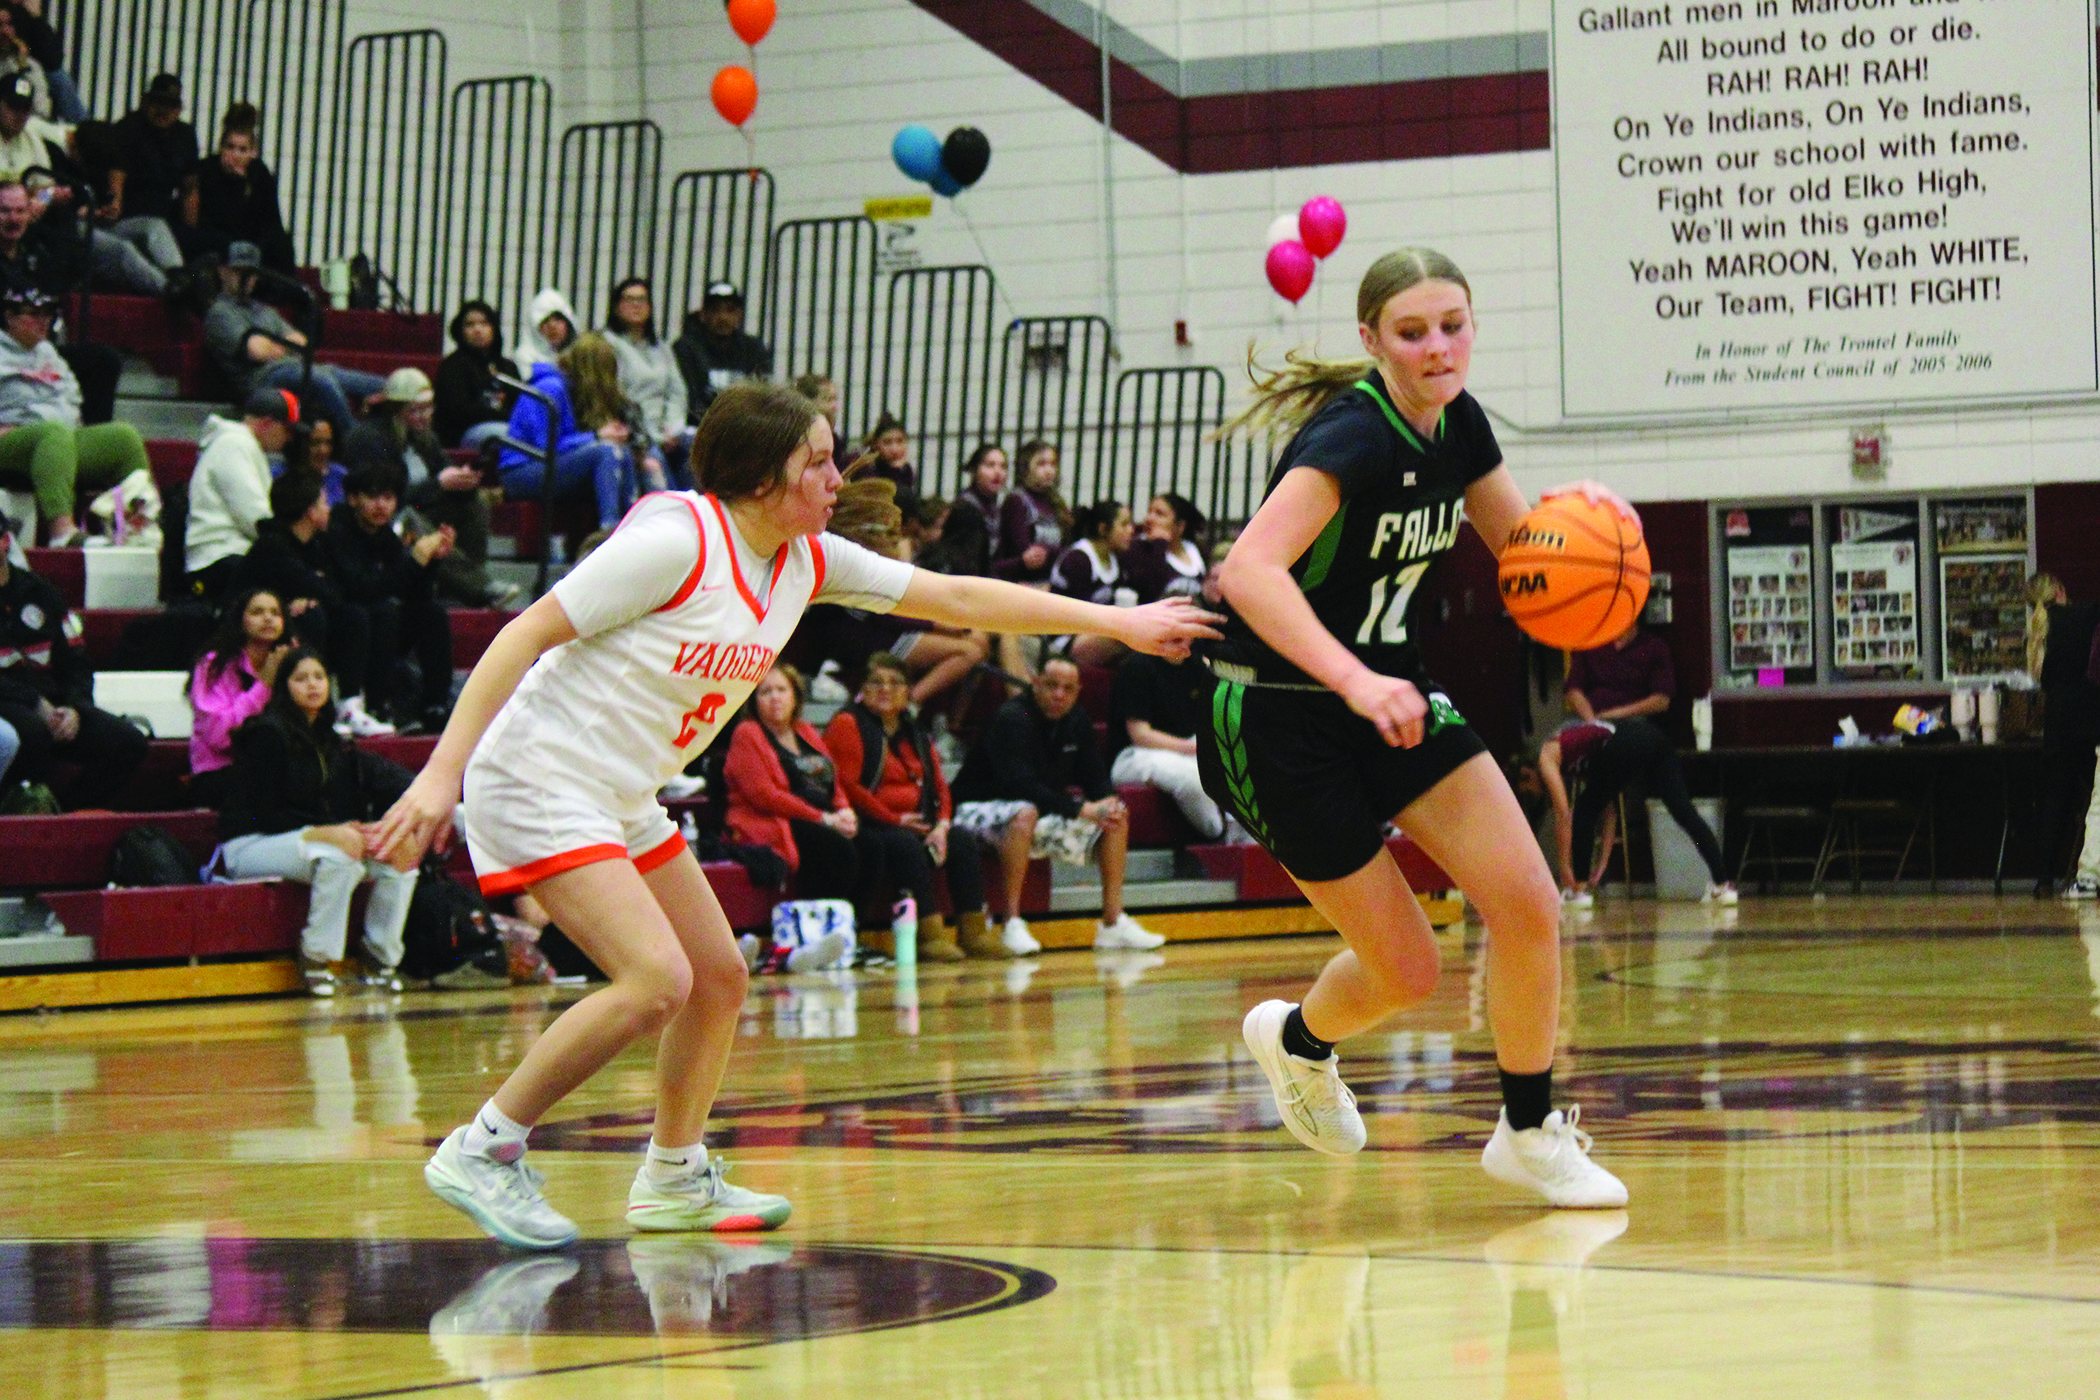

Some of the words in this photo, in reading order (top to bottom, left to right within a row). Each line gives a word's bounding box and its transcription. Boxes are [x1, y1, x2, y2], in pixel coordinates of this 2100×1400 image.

[1578, 5, 1672, 34] Gallant
[1686, 1, 1743, 24] men
[1756, 0, 1779, 18] in
[1657, 38, 1689, 64] All
[1701, 29, 1786, 60] bound
[1800, 29, 1828, 52] to
[1840, 24, 1876, 50] do
[1889, 25, 1918, 46] or
[1931, 16, 1981, 43] die.
[1707, 68, 1771, 97] RAH!
[1784, 62, 1850, 91] RAH!
[1863, 56, 1929, 85] RAH!
[1613, 115, 1651, 142] On
[1663, 113, 1695, 137] Ye
[1707, 108, 1812, 136] Indians,
[1825, 100, 1864, 126] On
[1877, 96, 1909, 122] Ye
[1922, 91, 2031, 119] Indians,
[1617, 152, 1703, 178] Crown
[1716, 151, 1760, 171] our
[1773, 137, 1866, 168] school
[1878, 132, 1936, 160] with
[1950, 130, 2028, 155] fame.
[1657, 187, 1723, 215] Fight
[1738, 182, 1775, 206] for
[1789, 177, 1831, 203] old
[1844, 173, 1905, 200] Elko
[1917, 167, 1987, 199] High,
[1670, 217, 1733, 245] We'll
[1741, 216, 1787, 240] win
[1800, 211, 1849, 237] this
[1862, 203, 1948, 238] game!
[1629, 257, 1693, 283] Yeah
[1705, 248, 1838, 279] MAROON,
[1851, 243, 1917, 271] Yeah
[1929, 236, 2029, 266] WHITE,
[1655, 294, 1703, 320] Our
[1716, 289, 1795, 316] Team,
[1807, 281, 1897, 311] FIGHT!
[1910, 275, 2001, 306] FIGHT!
